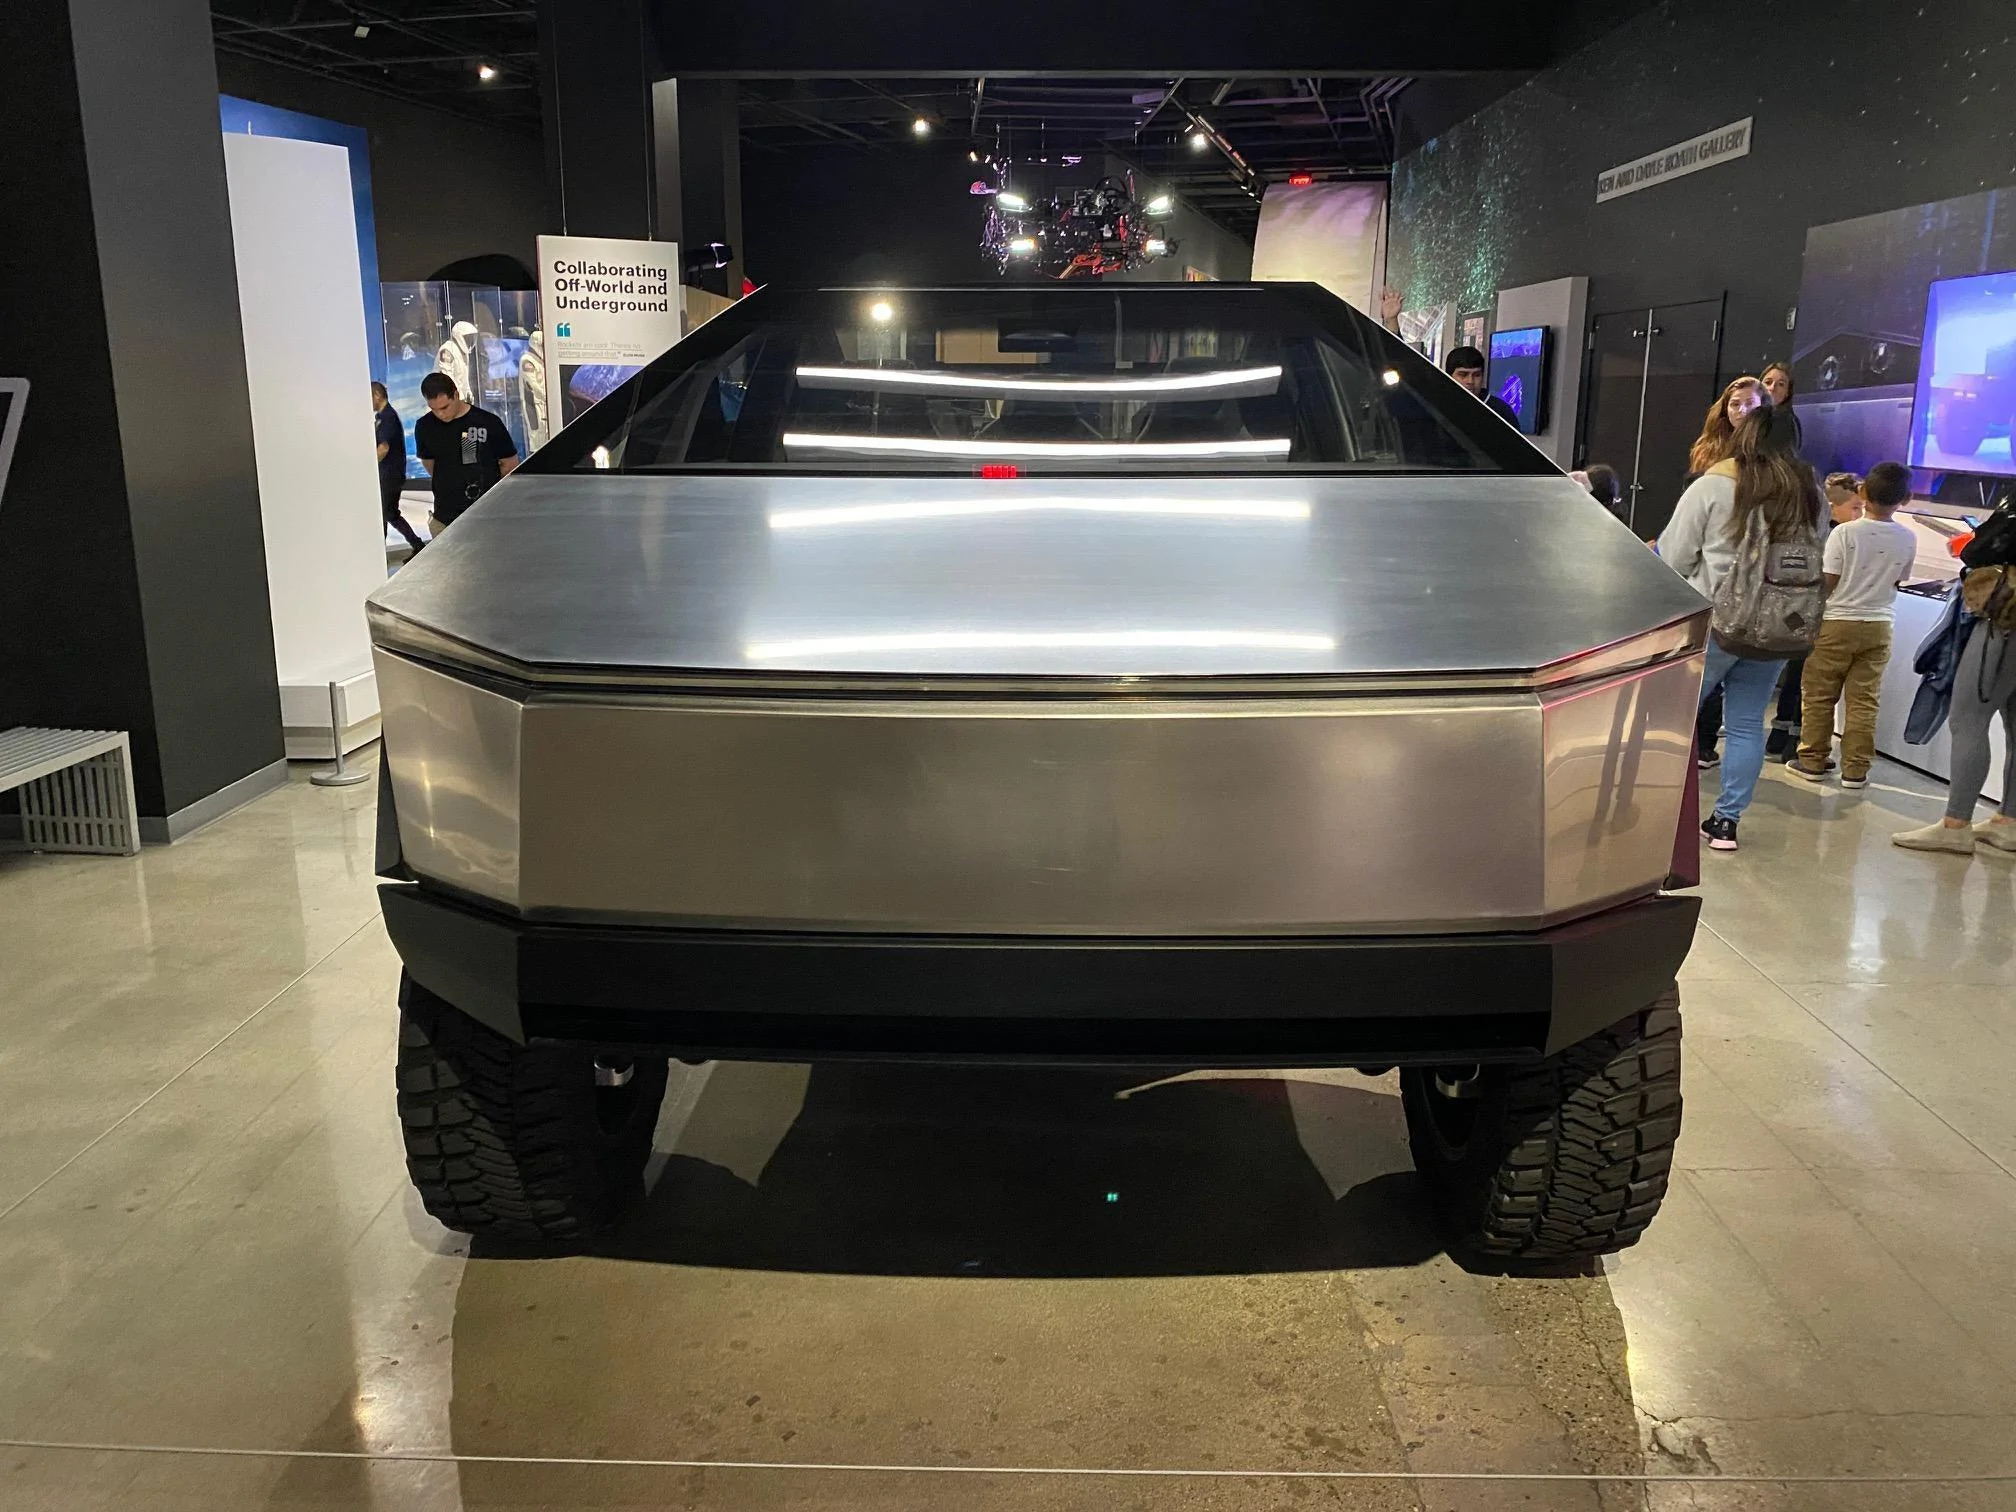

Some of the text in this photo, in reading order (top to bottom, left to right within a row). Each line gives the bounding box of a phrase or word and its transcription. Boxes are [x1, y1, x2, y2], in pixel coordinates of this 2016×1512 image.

[1699, 128, 1747, 160] GALLERY
[553, 260, 667, 281] Collaborating
[554, 278, 667, 295] Off-World and
[556, 296, 668, 313] Underground
